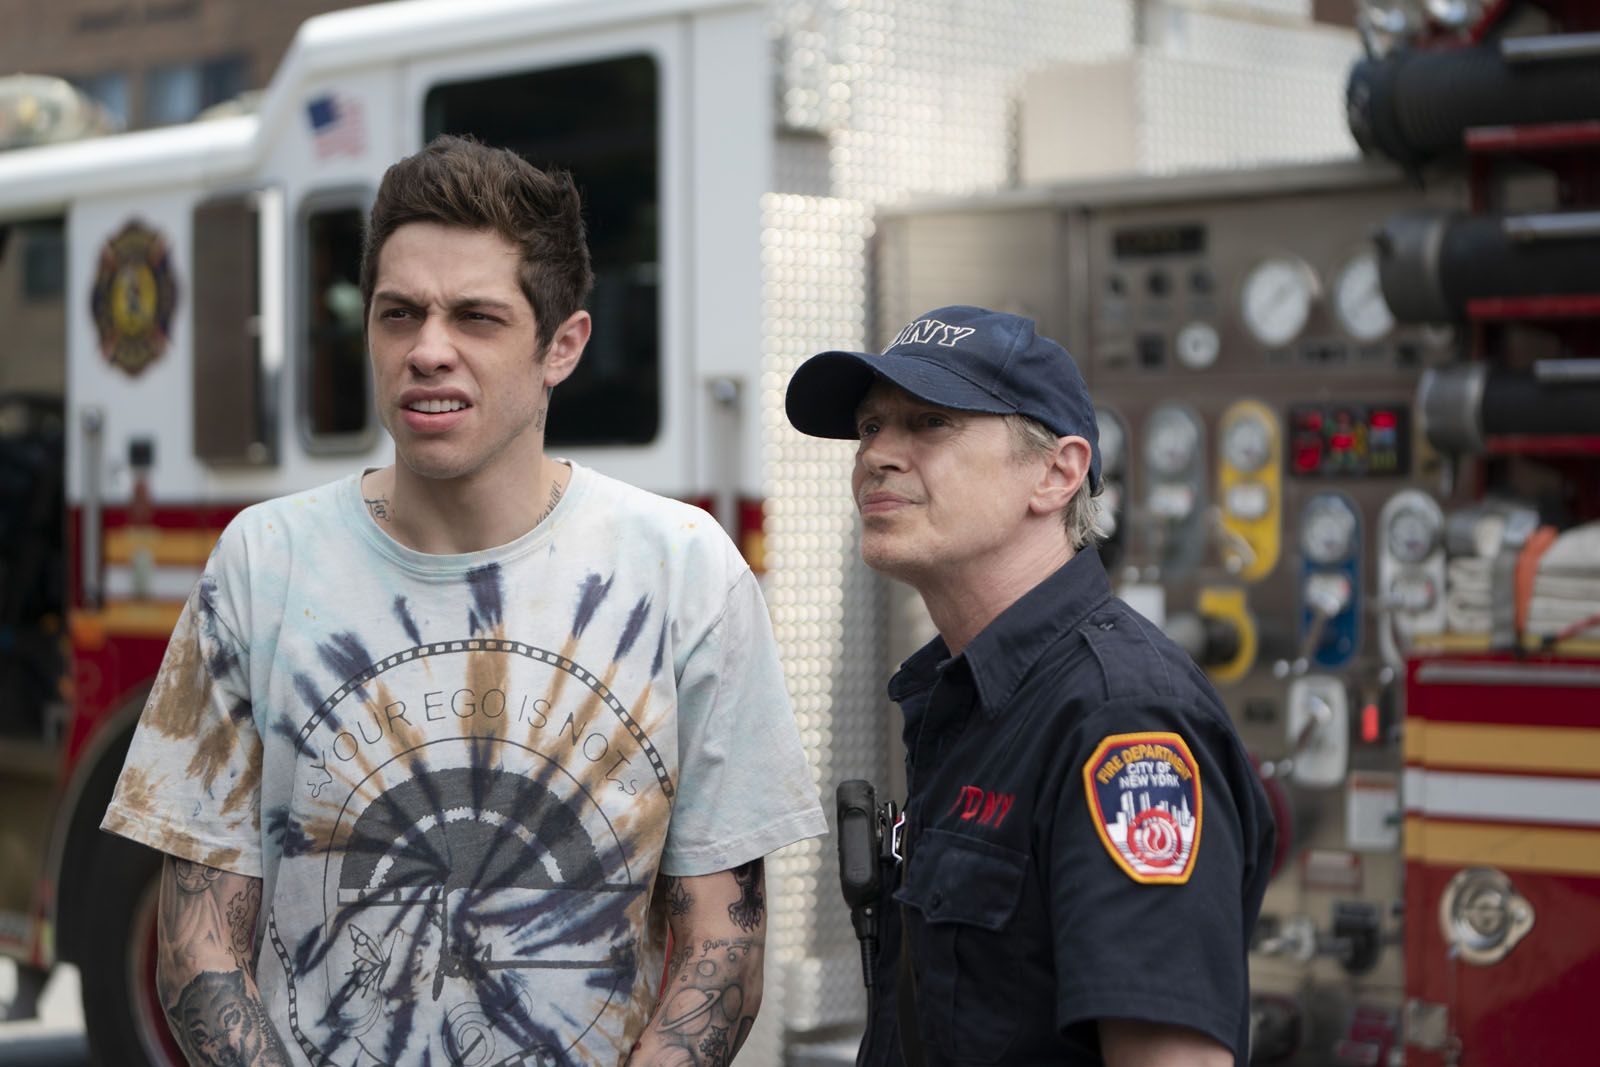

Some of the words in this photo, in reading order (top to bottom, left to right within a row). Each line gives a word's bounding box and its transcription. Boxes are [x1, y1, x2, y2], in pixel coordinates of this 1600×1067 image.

[307, 701, 413, 798] YOUR
[424, 688, 506, 721] EGO
[518, 695, 551, 728] IS
[559, 711, 638, 796] NOT
[1097, 755, 1124, 784] FIRE
[1121, 744, 1192, 780] DEPARTMENT
[1126, 762, 1154, 775] CITY
[1156, 761, 1172, 775] OF
[1118, 775, 1149, 789] NEW
[1151, 773, 1180, 788] YORK
